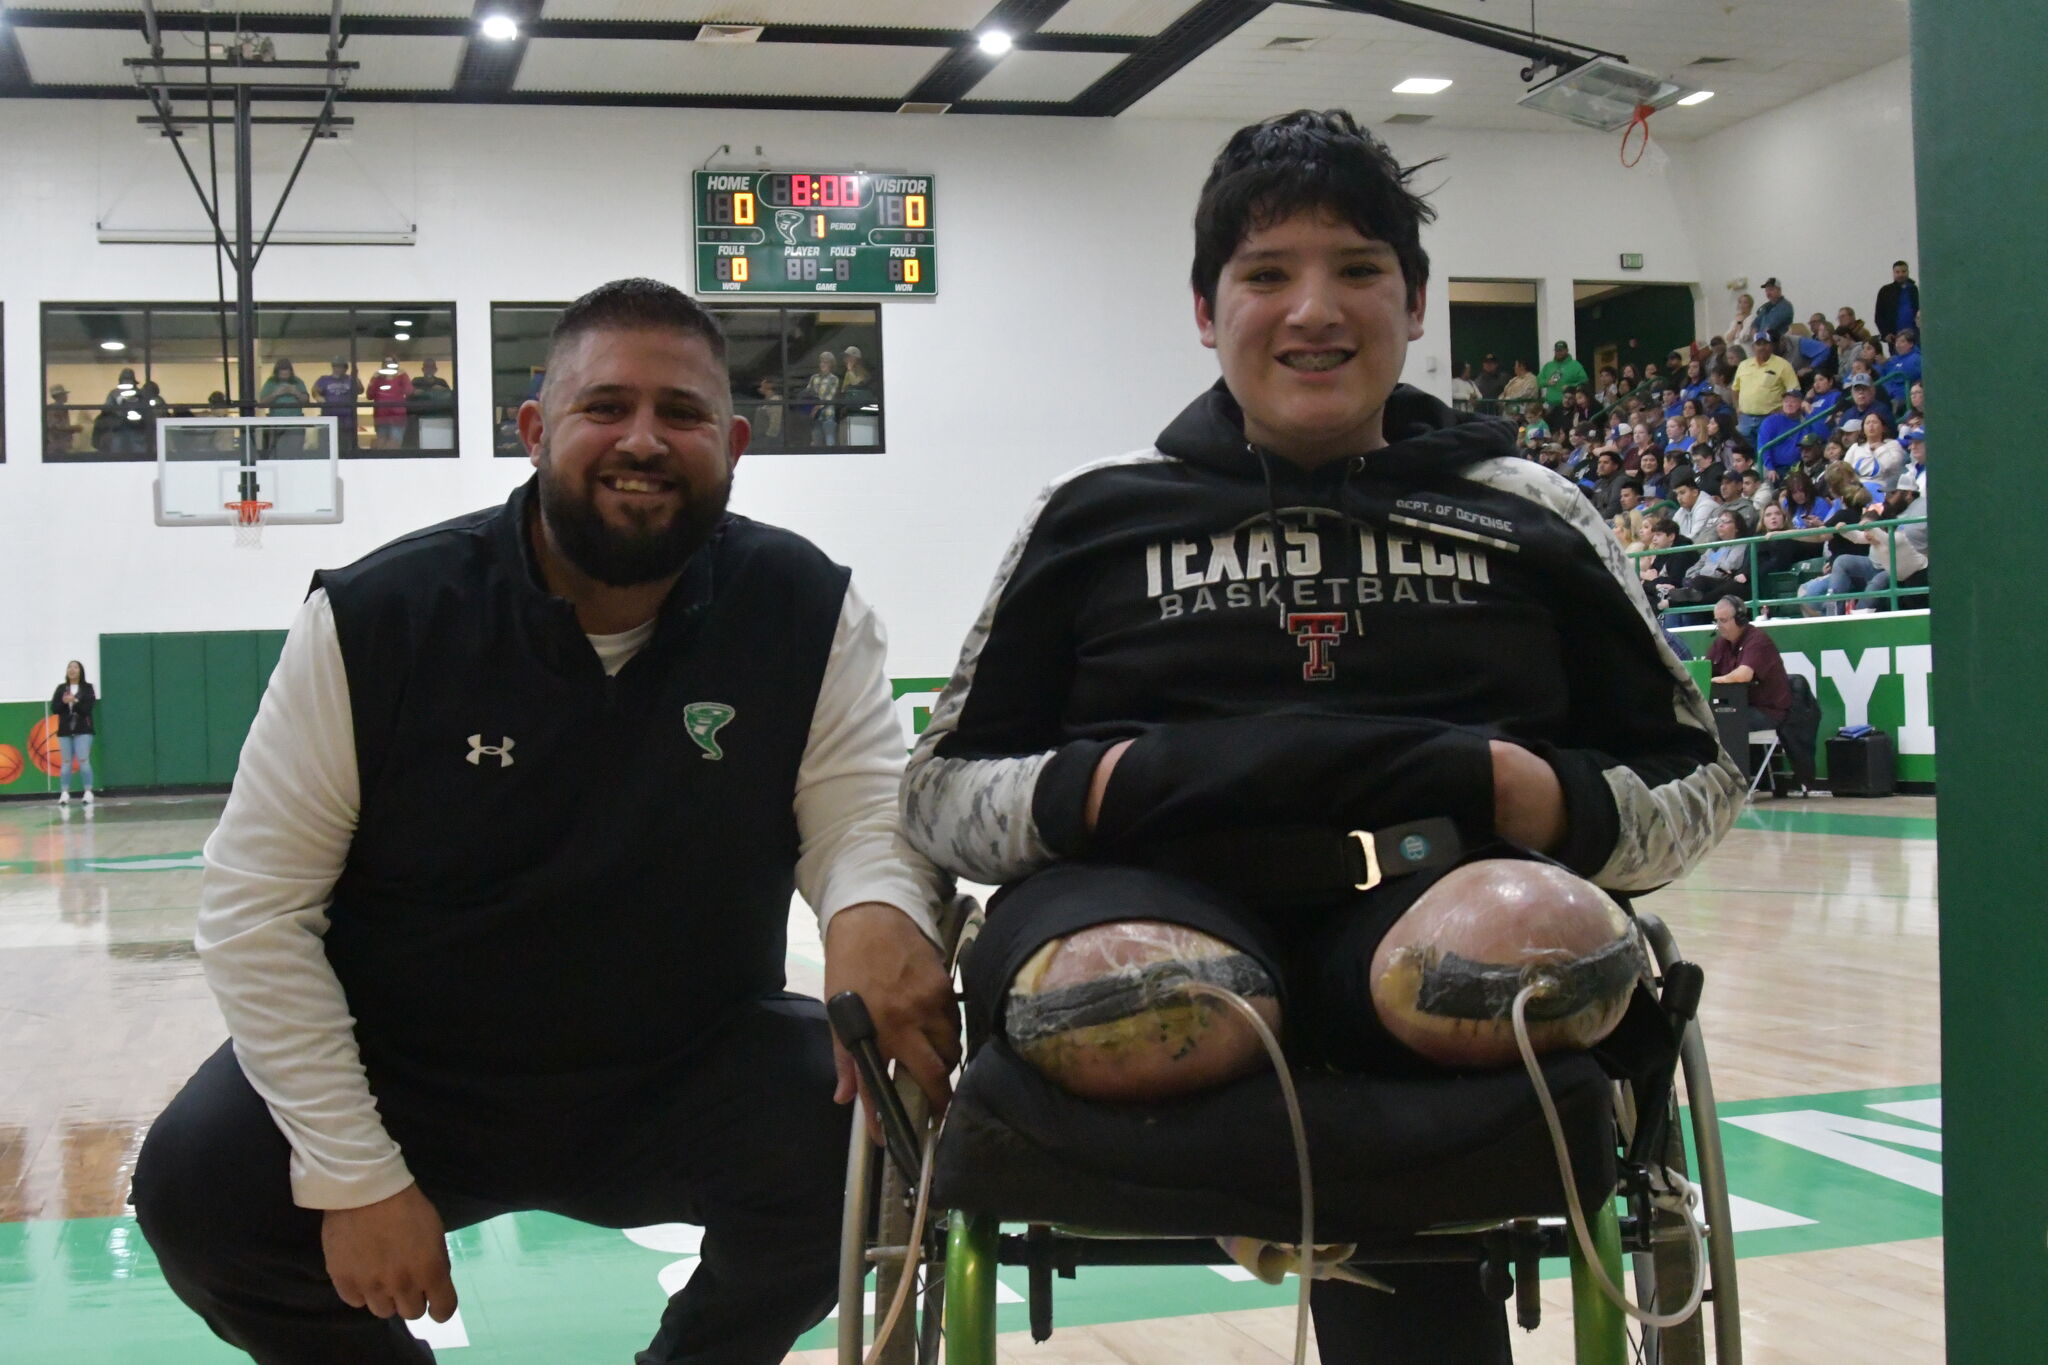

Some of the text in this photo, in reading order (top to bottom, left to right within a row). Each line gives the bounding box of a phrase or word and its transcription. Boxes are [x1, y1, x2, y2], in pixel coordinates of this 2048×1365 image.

[707, 176, 750, 191] HOME
[791, 174, 860, 207] 8:00
[875, 179, 928, 194] VISITOR
[734, 192, 754, 225] 0
[905, 195, 926, 227] 0
[830, 222, 857, 231] PERIOD
[718, 245, 745, 256] FOULS
[784, 246, 857, 257] PLAYER FOULS
[889, 247, 916, 258] FOULS
[732, 257, 748, 282] 0
[904, 259, 920, 283] 0
[722, 282, 741, 291] WON
[815, 283, 837, 292] GAME
[894, 284, 913, 292] WON
[1435, 504, 1453, 516] OF
[1456, 508, 1513, 533] DEFENSE
[1159, 577, 1478, 620] BASKETBALL
